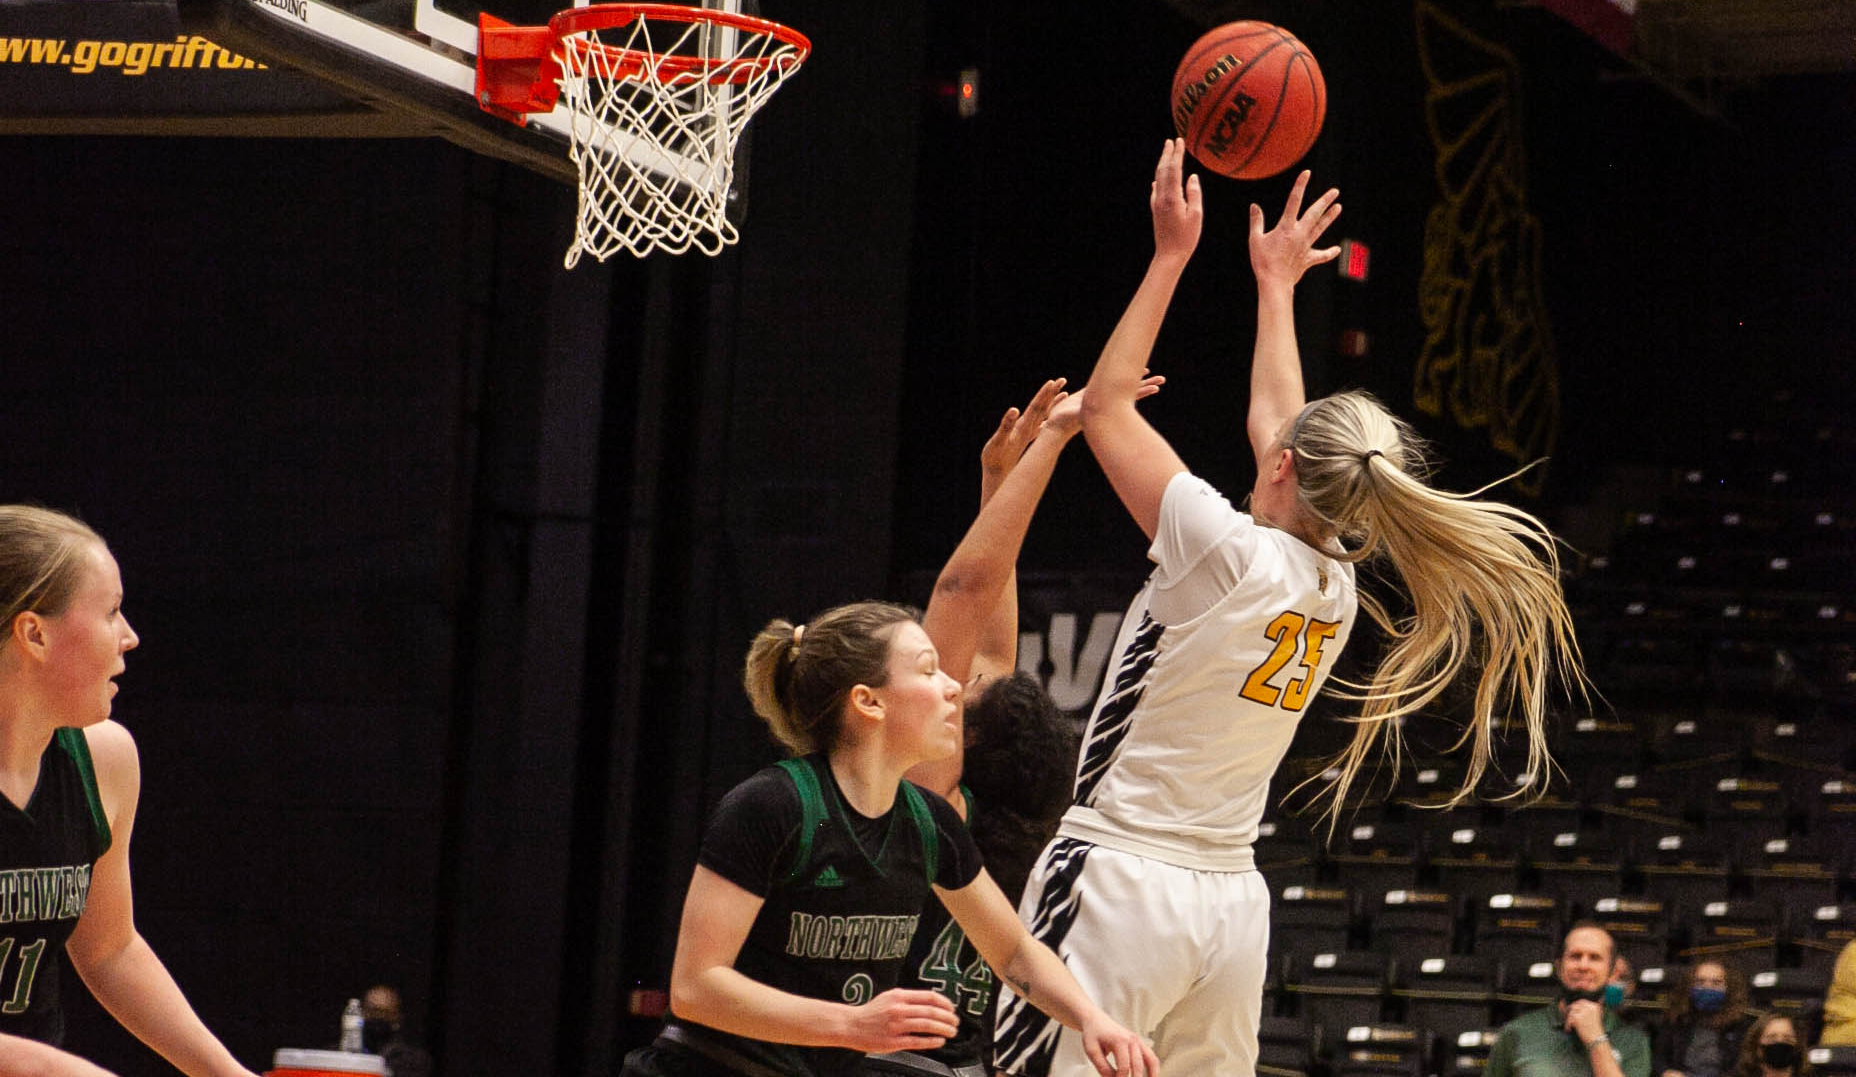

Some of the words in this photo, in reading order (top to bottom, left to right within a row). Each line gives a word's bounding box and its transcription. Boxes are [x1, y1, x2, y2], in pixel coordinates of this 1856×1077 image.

[1204, 92, 1257, 159] NCAA
[1238, 610, 1343, 712] 25
[918, 917, 993, 1016] 44
